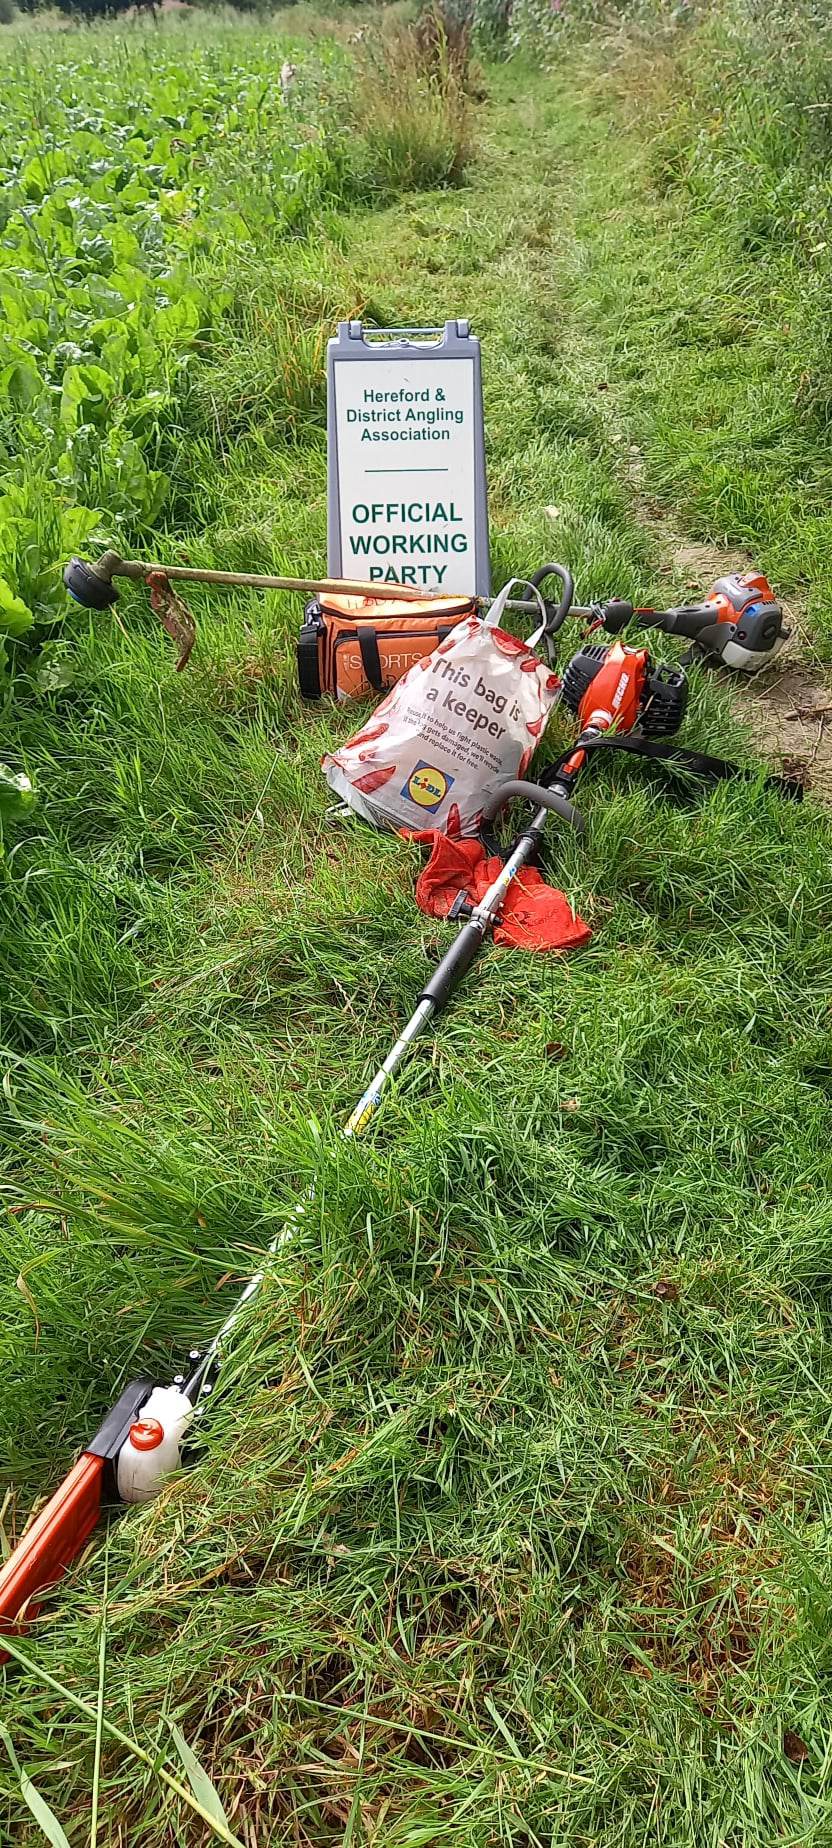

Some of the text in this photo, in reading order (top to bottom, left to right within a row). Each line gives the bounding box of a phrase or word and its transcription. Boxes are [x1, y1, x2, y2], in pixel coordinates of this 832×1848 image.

[364, 388, 446, 403] Hereford &
[346, 407, 464, 424] District Angling
[361, 428, 450, 441] Association
[352, 502, 463, 523] OFFICIAL
[349, 533, 468, 555] WORKING
[369, 565, 448, 585] PARTY
[432, 657, 471, 688] This
[474, 677, 508, 714] bag
[509, 700, 521, 722] is
[426, 687, 506, 740] a keeper
[434, 719, 448, 731] help
[448, 728, 456, 736] us
[456, 731, 471, 744] fight
[470, 742, 489, 756] plastic
[427, 727, 441, 738] gets
[441, 734, 470, 756] damaged,
[483, 759, 499, 774] recycle
[428, 737, 451, 754] replace
[451, 749, 457, 757] it
[456, 752, 466, 762] for
